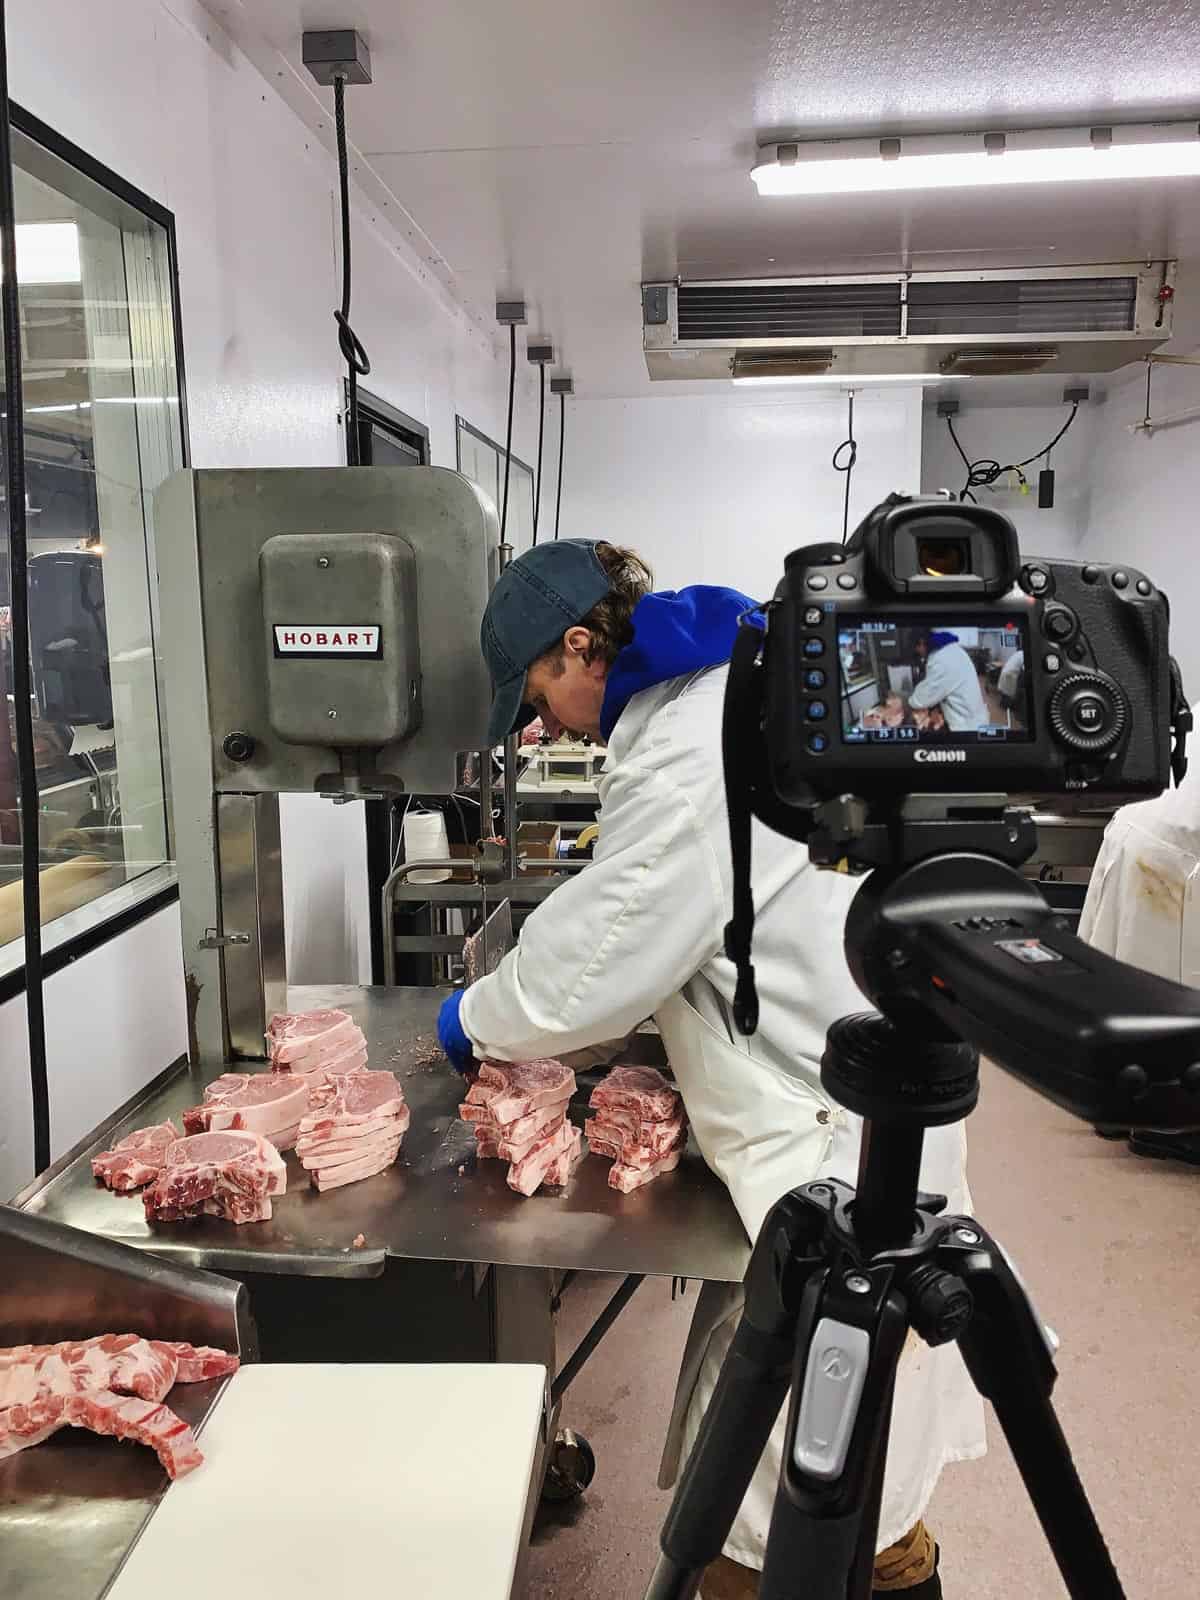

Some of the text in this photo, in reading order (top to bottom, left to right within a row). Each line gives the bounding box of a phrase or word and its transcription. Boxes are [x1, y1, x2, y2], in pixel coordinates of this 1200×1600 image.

[284, 632, 373, 645] HOBART
[1081, 709, 1097, 719] SET
[913, 749, 967, 762] Canon
